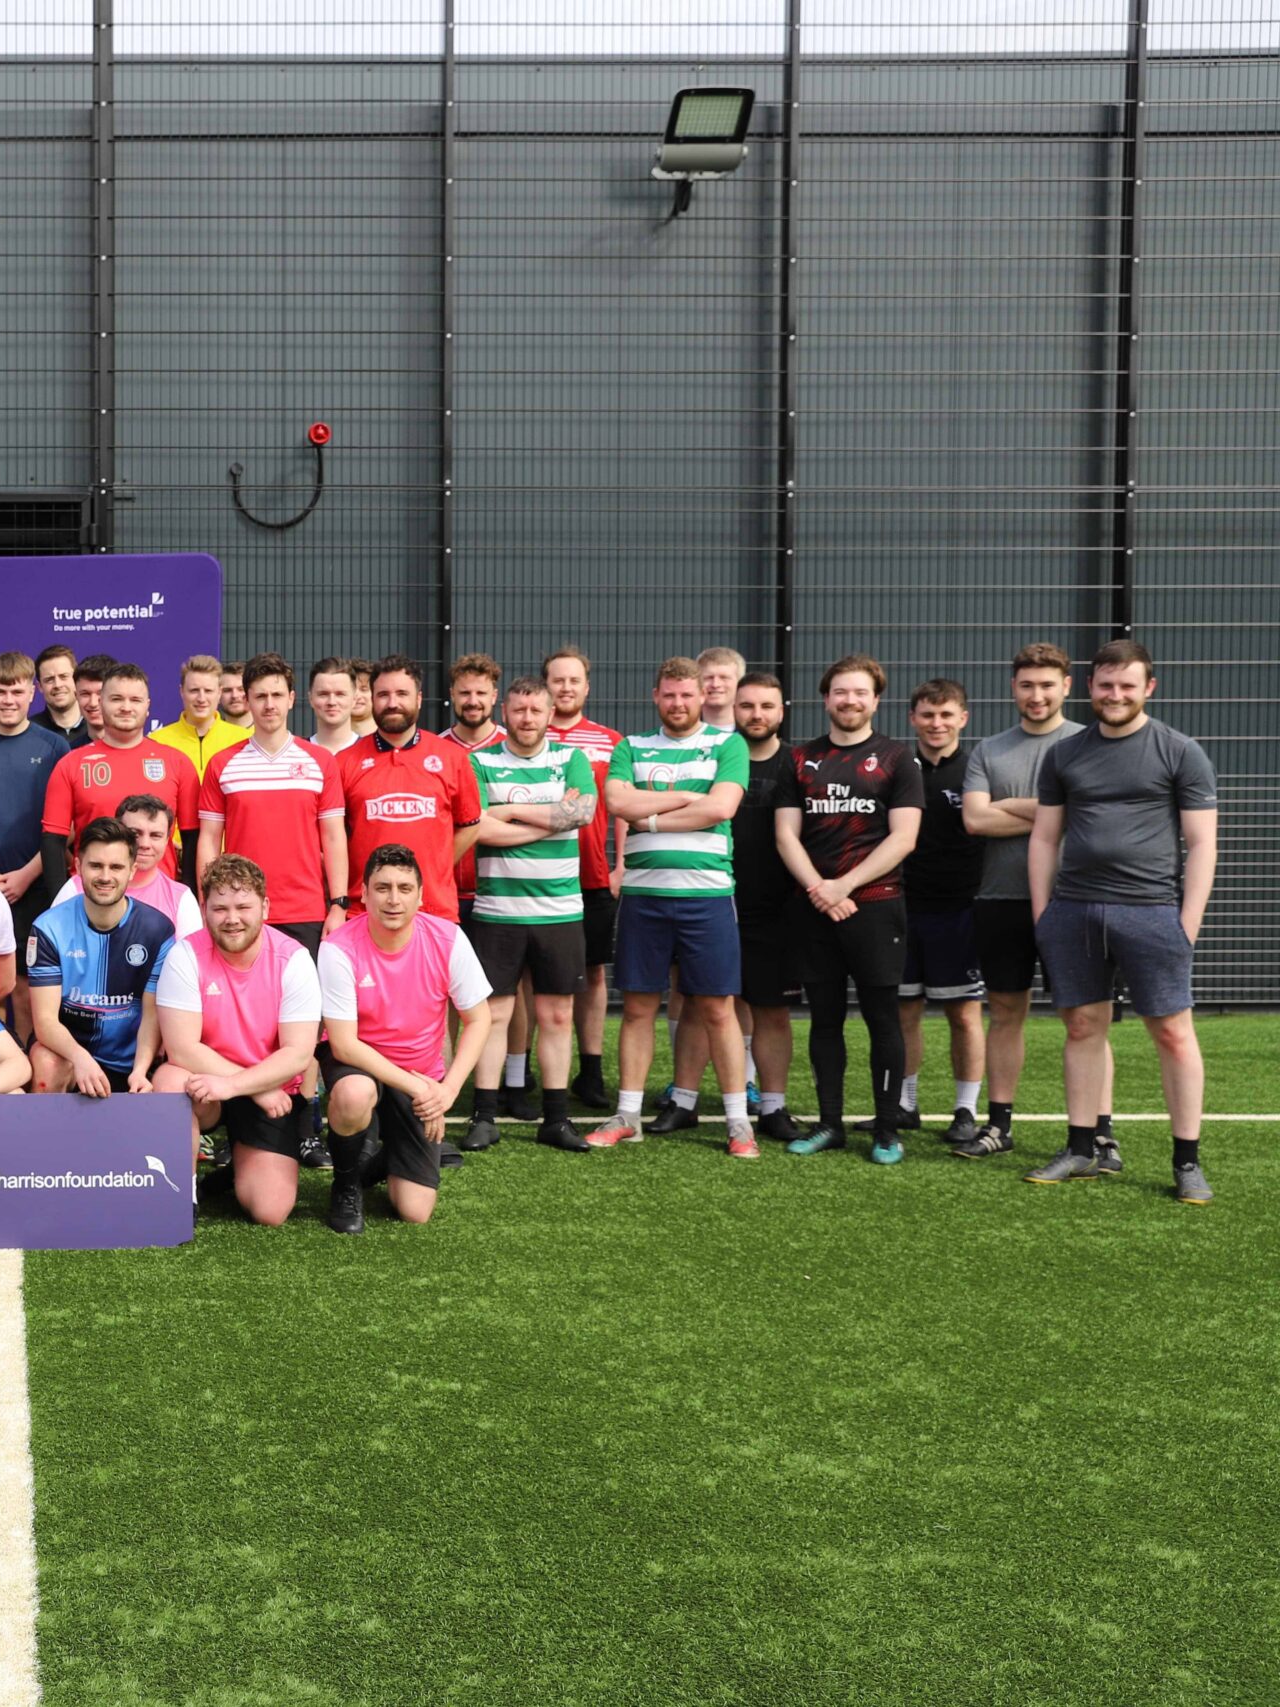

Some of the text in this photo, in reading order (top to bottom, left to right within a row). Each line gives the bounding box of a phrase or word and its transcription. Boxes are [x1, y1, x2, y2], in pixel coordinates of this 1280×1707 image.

[53, 604, 153, 622] true potential
[80, 761, 112, 789] 10
[827, 783, 851, 798] Fly
[368, 800, 436, 816] DICKENS
[805, 795, 876, 814] Emirates
[69, 986, 134, 1006] Dreams
[63, 1007, 79, 1016] The
[80, 1011, 97, 1019] Bed
